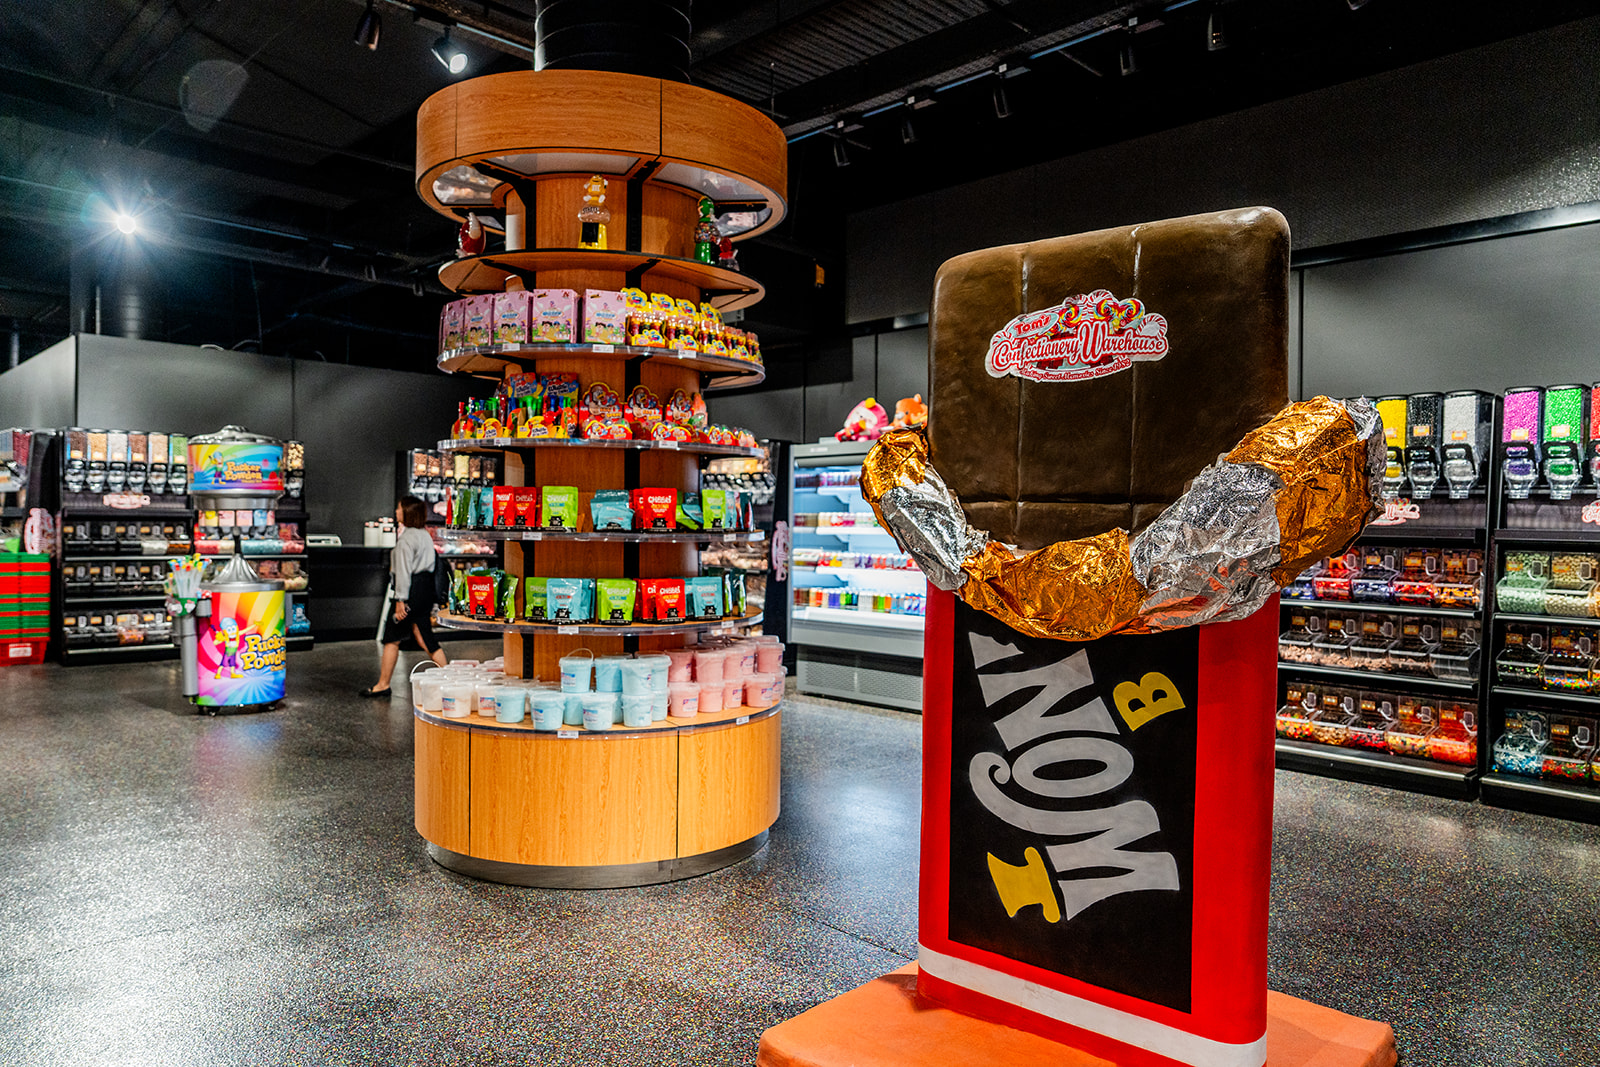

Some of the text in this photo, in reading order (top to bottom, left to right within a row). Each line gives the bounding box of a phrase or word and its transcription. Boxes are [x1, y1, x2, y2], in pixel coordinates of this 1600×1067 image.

[1014, 314, 1051, 335] Tom's
[993, 321, 1165, 368] Confectionery Warehouse
[226, 461, 261, 472] Pucker
